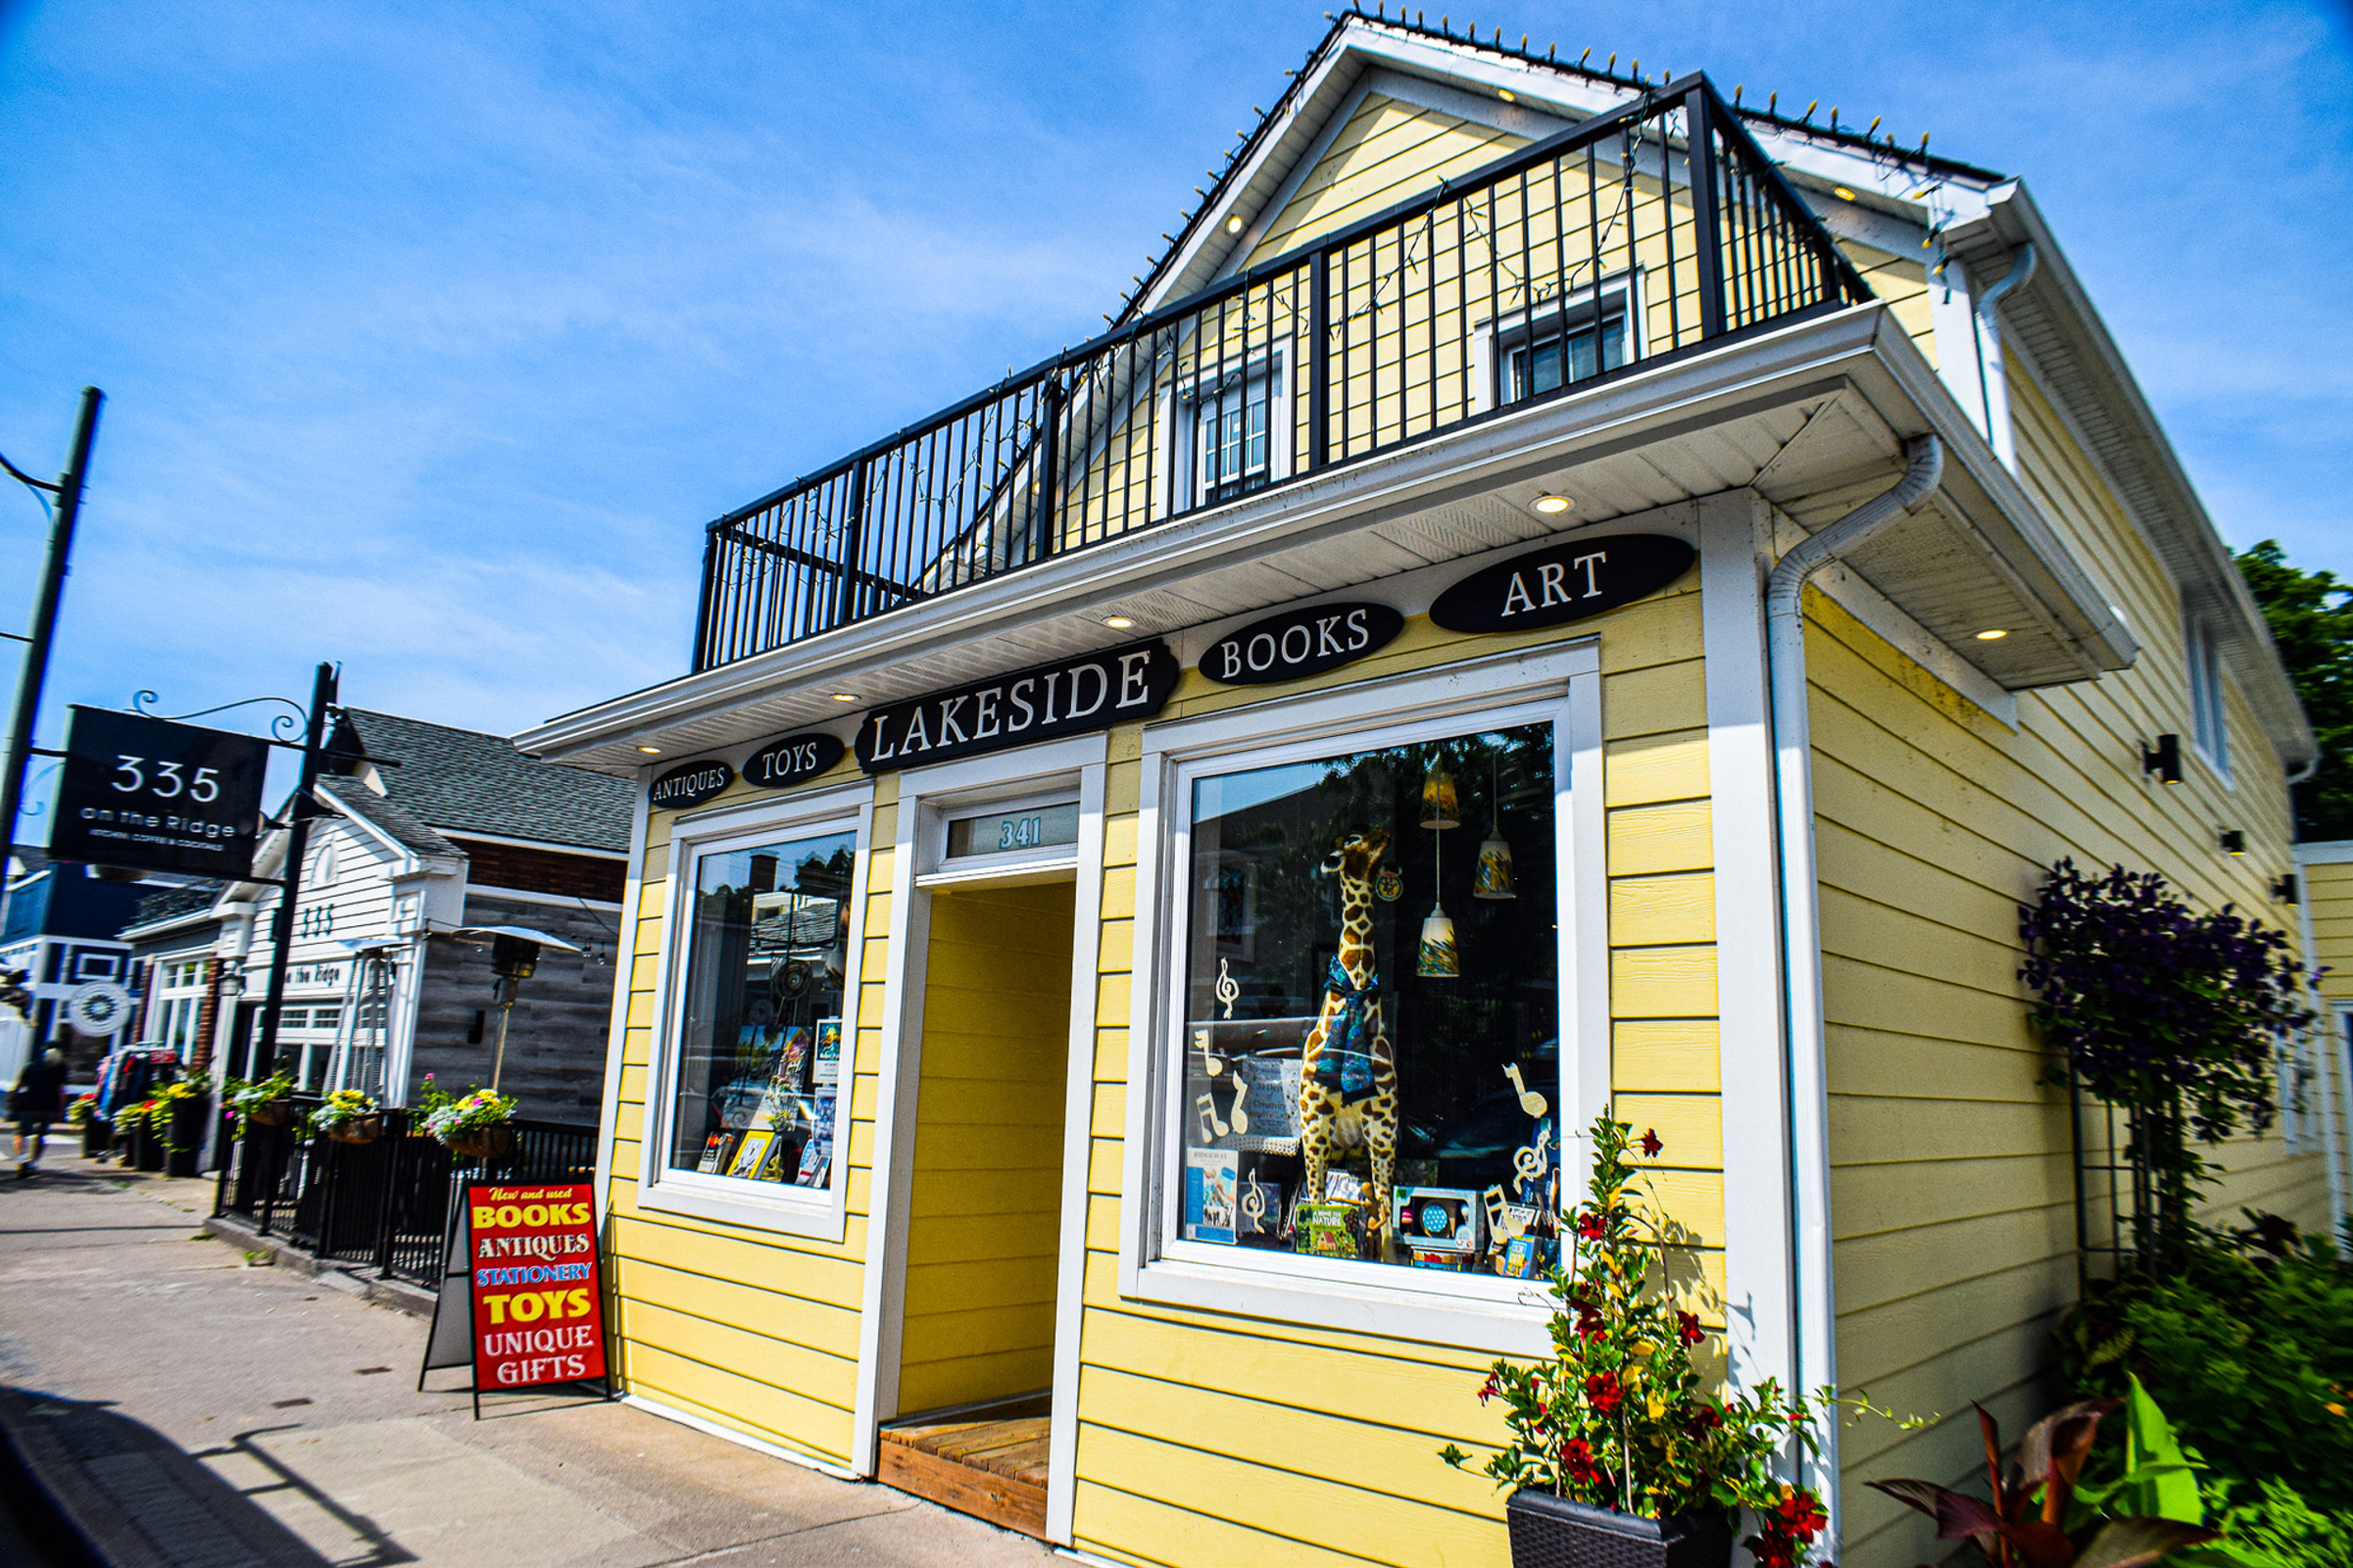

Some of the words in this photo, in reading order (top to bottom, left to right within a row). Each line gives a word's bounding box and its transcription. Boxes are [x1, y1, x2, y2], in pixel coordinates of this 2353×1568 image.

[1500, 552, 1608, 617] ART
[1221, 609, 1370, 679] BOOKS
[870, 650, 1151, 763] LAKESIDE
[761, 742, 819, 780] TOYS
[110, 754, 220, 804] 335
[652, 766, 727, 803] ANTIQUES
[80, 807, 114, 822] on
[119, 809, 161, 828] the
[165, 815, 235, 839] Ridge
[999, 816, 1042, 850] 341
[300, 903, 335, 939] 335
[488, 1188, 519, 1201] New
[520, 1188, 544, 1200] and
[546, 1187, 572, 1199] used
[472, 1202, 592, 1229] BOOKS
[1312, 1216, 1342, 1227] NATURE
[478, 1233, 590, 1261] ANTIQUES
[476, 1261, 593, 1288] STATIONERY
[482, 1288, 592, 1325] TOYS
[483, 1324, 595, 1358] UNIQUE
[496, 1353, 586, 1384] GIFTS
